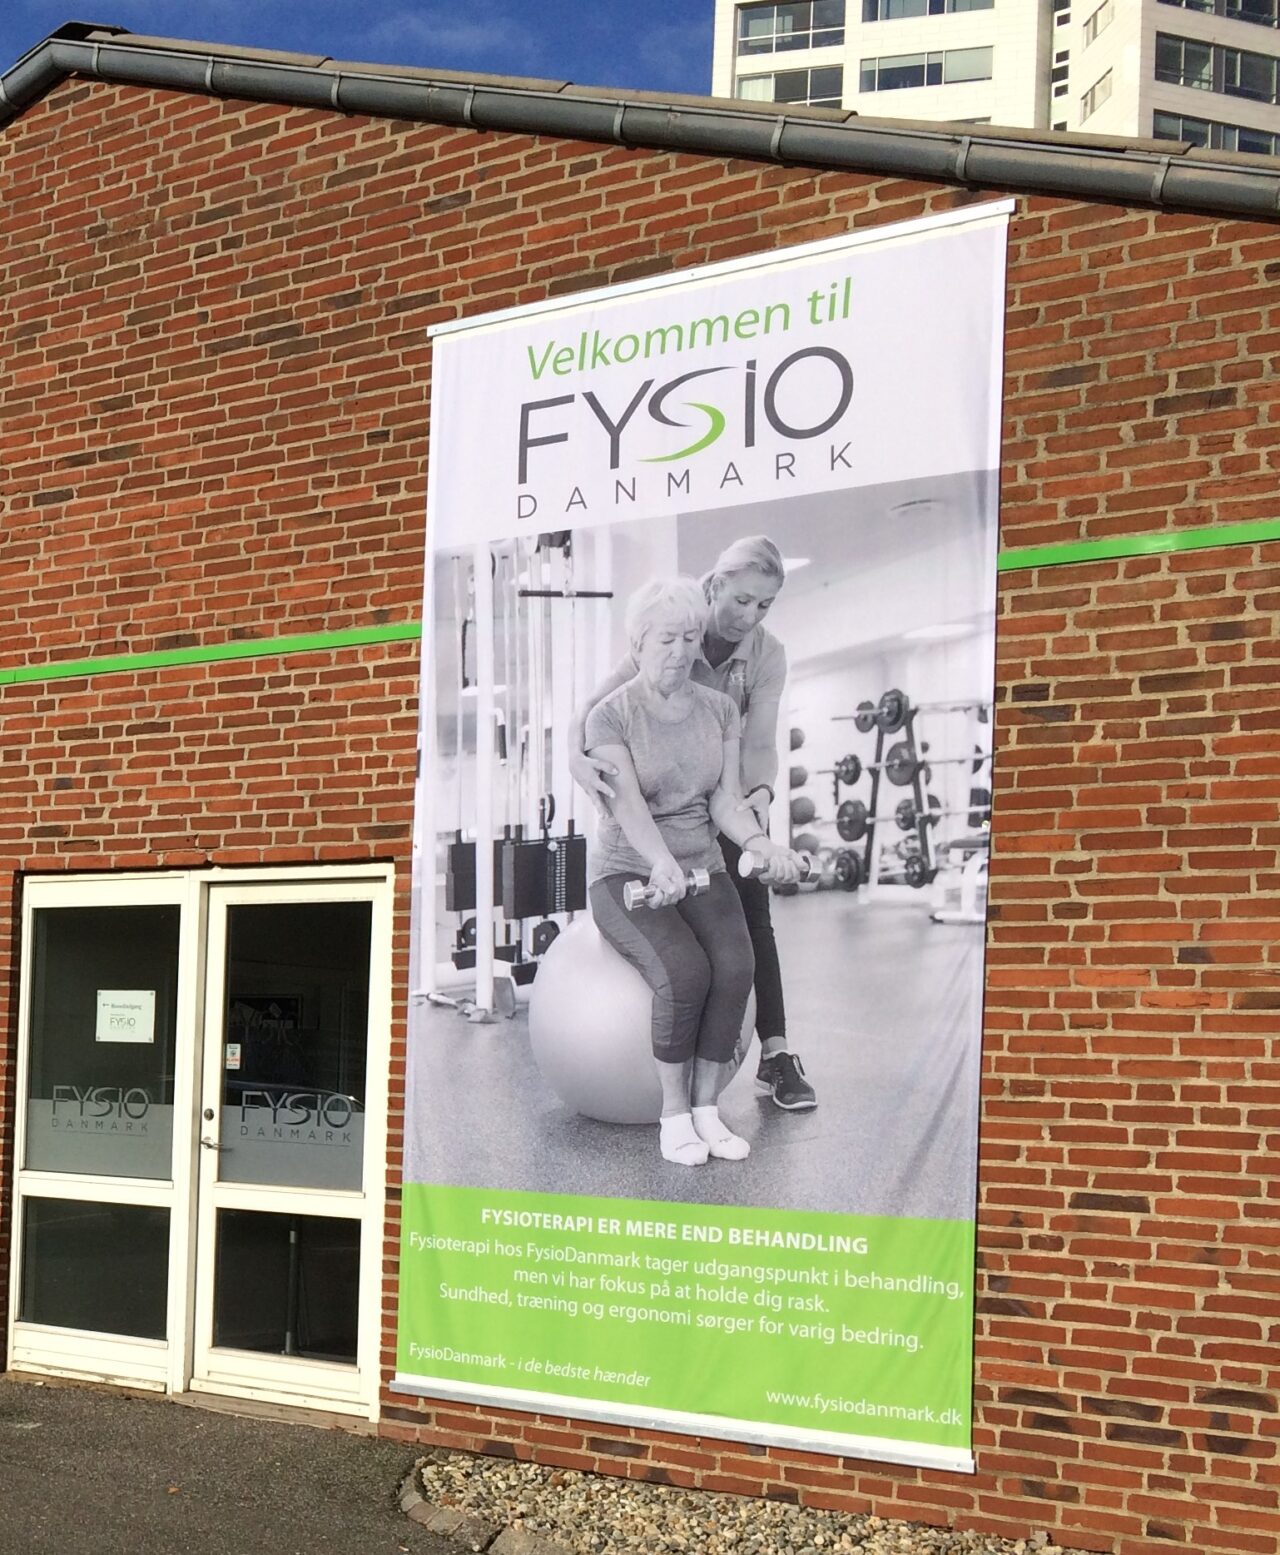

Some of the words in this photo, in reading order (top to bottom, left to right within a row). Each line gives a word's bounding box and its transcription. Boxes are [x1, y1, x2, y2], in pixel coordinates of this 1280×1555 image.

[526, 301, 791, 380] Velkommen
[807, 277, 853, 326] til
[517, 441, 854, 520] DANMARK
[52, 1085, 149, 1119] FYSIO
[241, 1090, 352, 1129] FYSIO
[51, 1118, 149, 1133] DANMARK
[240, 1125, 352, 1143] DANMARK
[481, 1209, 593, 1233] FYSIOTERAPI
[598, 1218, 621, 1236] ER
[626, 1220, 677, 1240] MERE
[681, 1224, 723, 1243] END
[728, 1227, 868, 1254] BEHANDLING
[409, 1232, 490, 1256] Fysioterapi
[495, 1240, 523, 1257] hos
[526, 1243, 641, 1269] FysioDanmark
[645, 1255, 689, 1275] tager
[694, 1259, 829, 1285] udgangspunkt
[833, 1271, 839, 1286] i
[844, 1271, 965, 1299] behandling,
[513, 1269, 548, 1285] men
[552, 1272, 565, 1286] vi
[569, 1273, 596, 1290] har
[600, 1275, 646, 1294] fokus
[650, 1280, 670, 1299] på
[674, 1284, 691, 1299] at
[696, 1284, 749, 1304] holde
[754, 1290, 783, 1311] dig
[787, 1294, 830, 1313] rask.
[439, 1283, 513, 1307] Sundhed,
[517, 1293, 578, 1316] træning
[582, 1303, 604, 1320] og
[609, 1304, 691, 1325] ergonomi
[696, 1313, 754, 1334] sørger
[759, 1316, 785, 1334] for
[789, 1323, 836, 1344] varig
[841, 1325, 924, 1352] bedring.
[409, 1342, 506, 1369] FysioDanmark
[517, 1357, 523, 1371] i
[524, 1358, 543, 1374] de
[545, 1359, 591, 1380] bedste
[594, 1366, 651, 1387] hænder
[766, 1390, 963, 1426] www.fysiodanmark.dk
